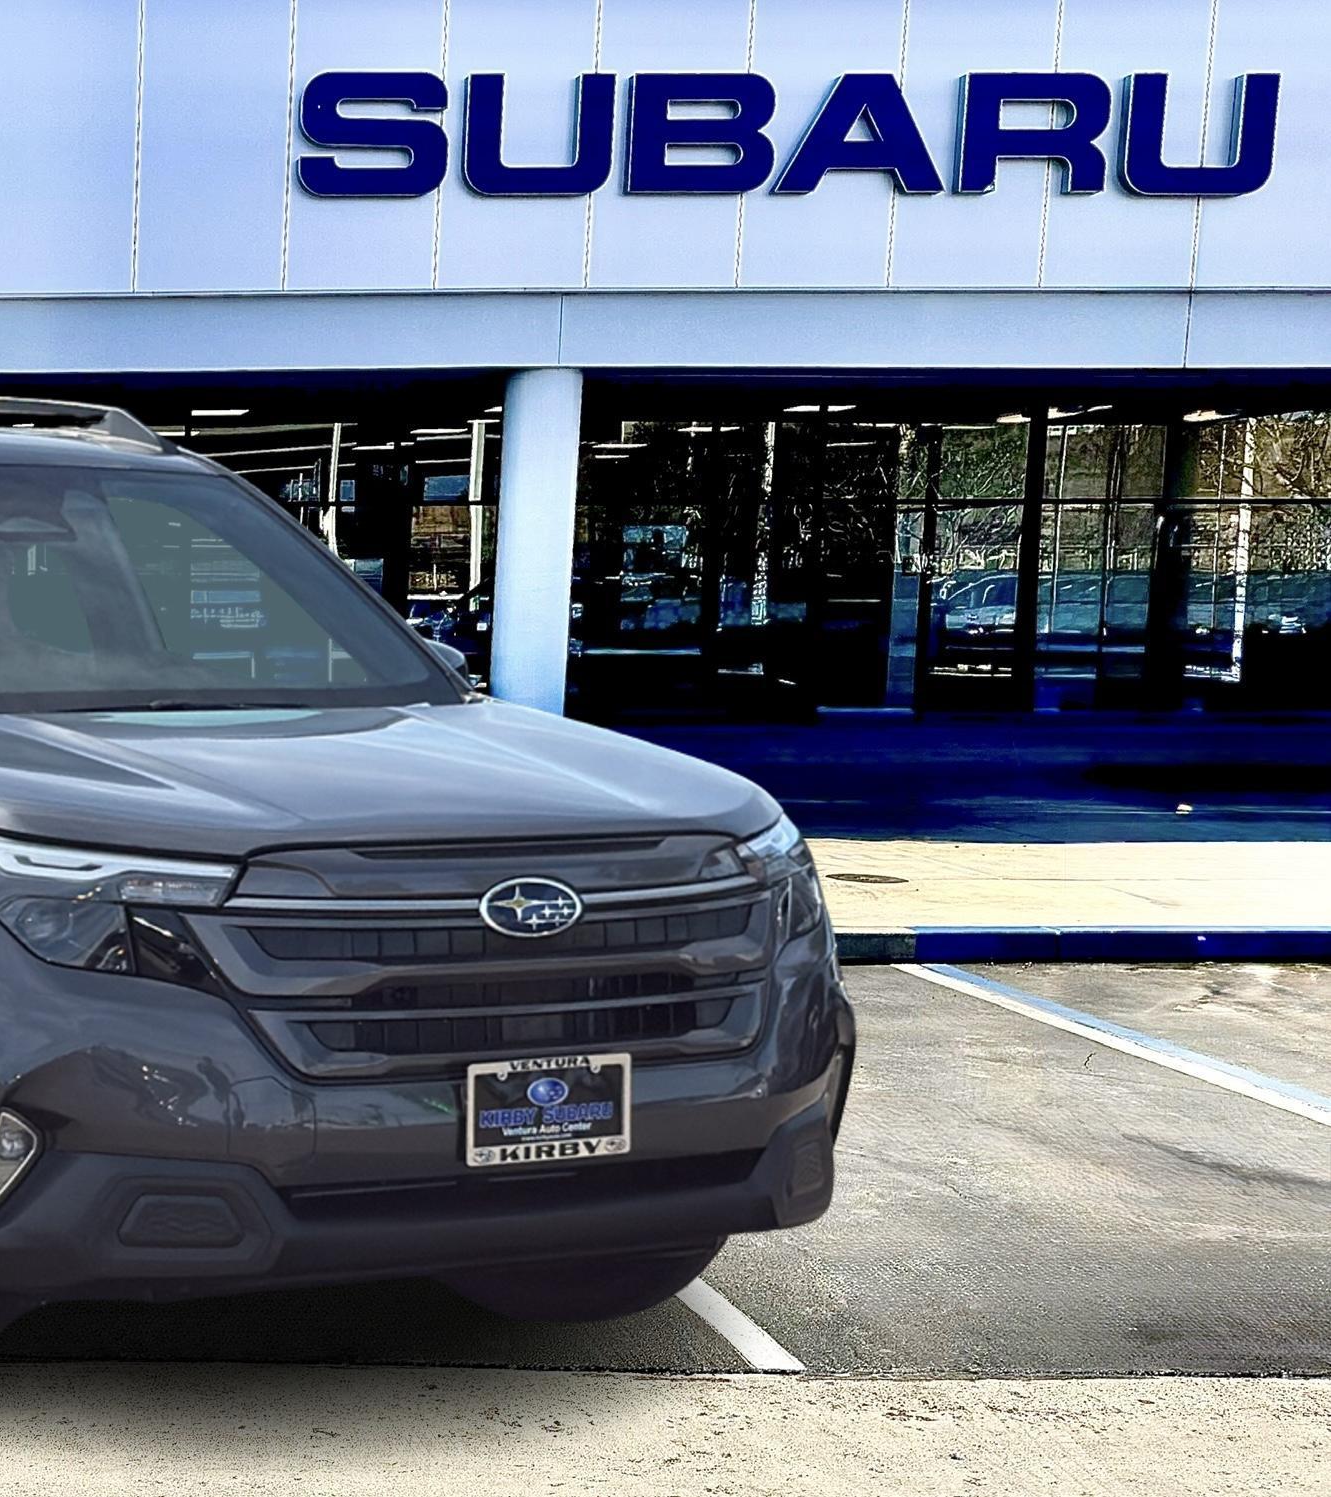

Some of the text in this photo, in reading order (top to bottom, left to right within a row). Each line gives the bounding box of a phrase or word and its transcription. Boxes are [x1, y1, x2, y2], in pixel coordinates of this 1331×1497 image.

[296, 72, 1280, 197] SUBARU
[510, 1056, 590, 1070] VENTURA
[479, 1101, 613, 1128] KIRBY SUBARU
[502, 1121, 592, 1136] Ventura Auto Center
[500, 1139, 601, 1161] KIRBY
